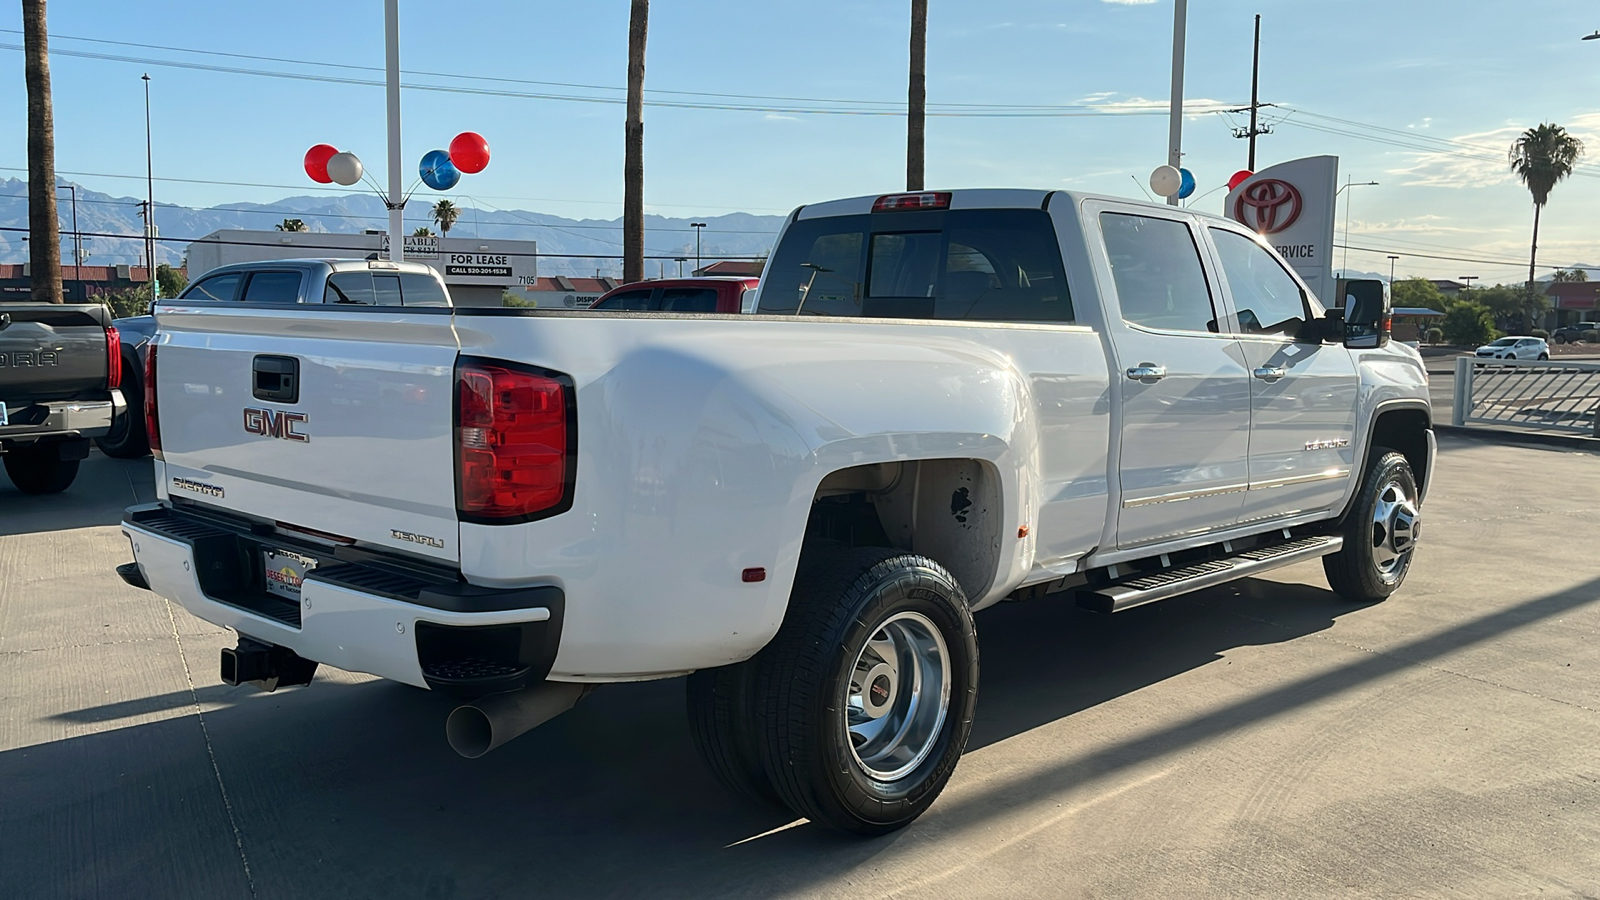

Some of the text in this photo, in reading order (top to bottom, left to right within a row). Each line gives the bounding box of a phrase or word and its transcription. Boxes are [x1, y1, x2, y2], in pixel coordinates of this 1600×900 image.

[383, 236, 438, 247] ALABLE
[1273, 244, 1314, 258] ERVICE
[451, 255, 507, 265] FOR LEASE
[518, 275, 535, 285] 7105
[243, 407, 310, 443] GMC
[173, 477, 225, 499] SIERRA
[390, 528, 444, 549] DENALI
